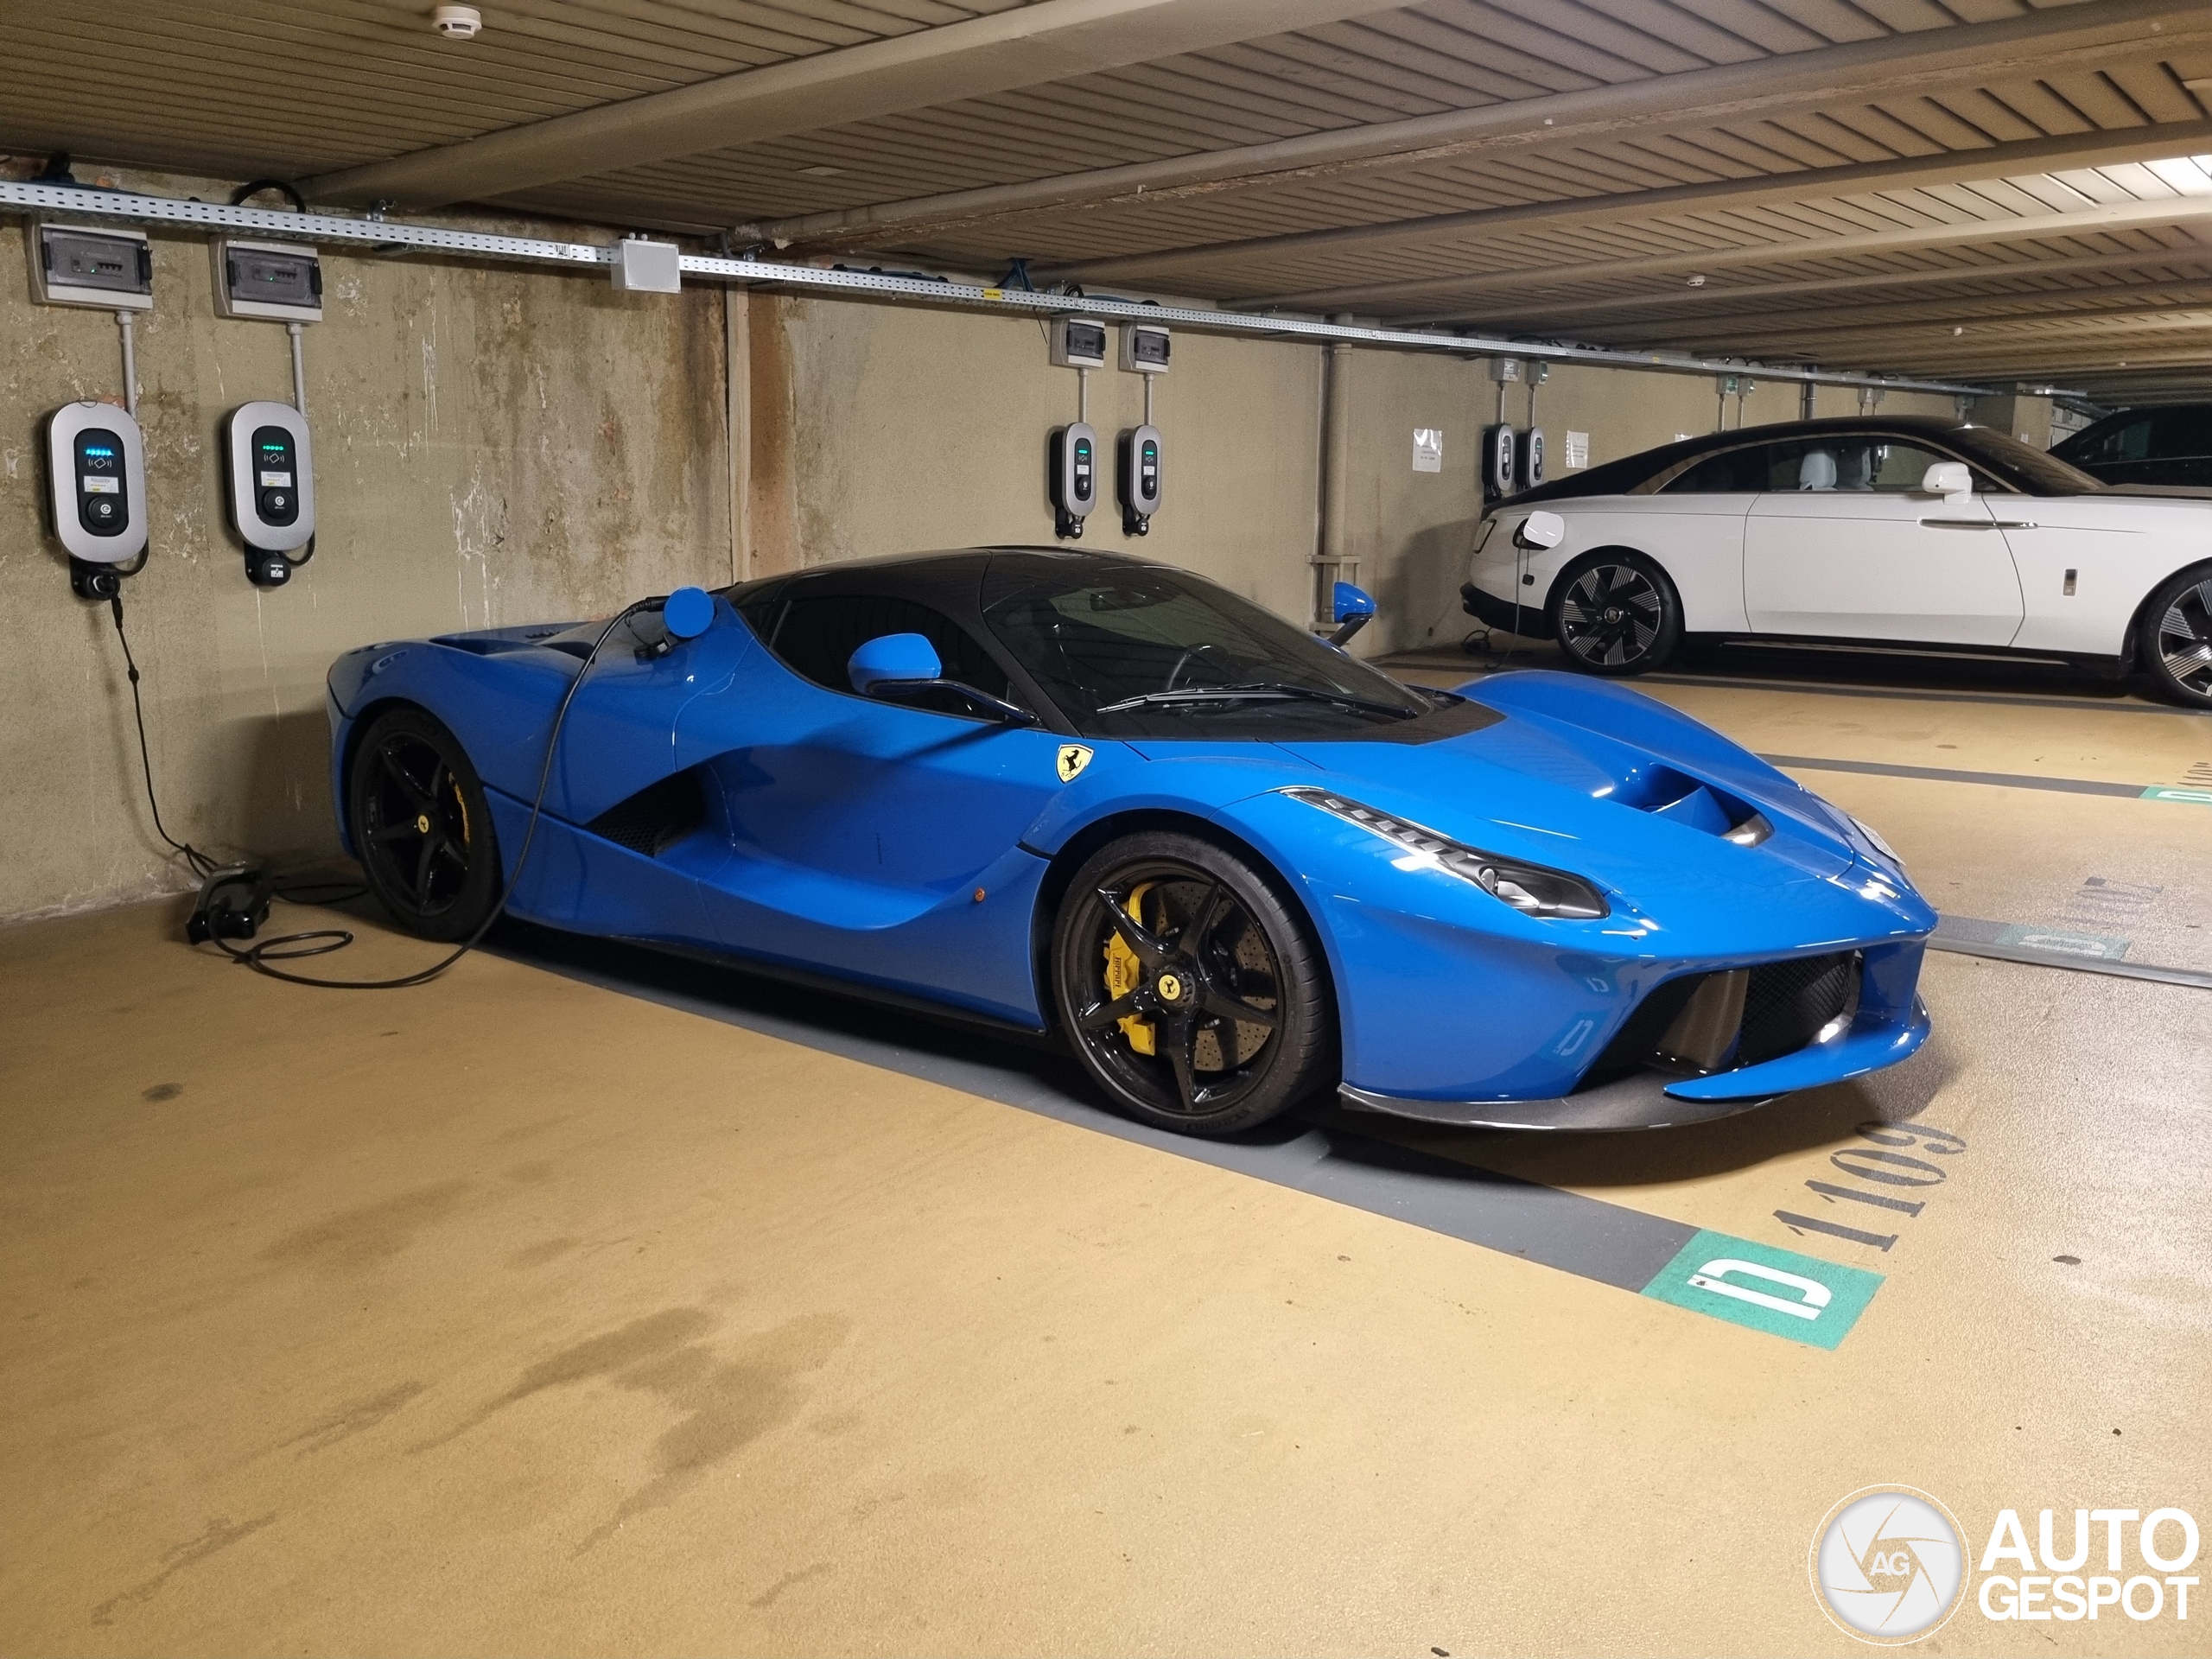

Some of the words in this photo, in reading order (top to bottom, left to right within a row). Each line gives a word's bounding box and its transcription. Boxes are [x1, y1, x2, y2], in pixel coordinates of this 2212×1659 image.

[2018, 934, 2107, 957] D
[1772, 1121, 1967, 1253] 1109
[1687, 1258, 1832, 1320] D
